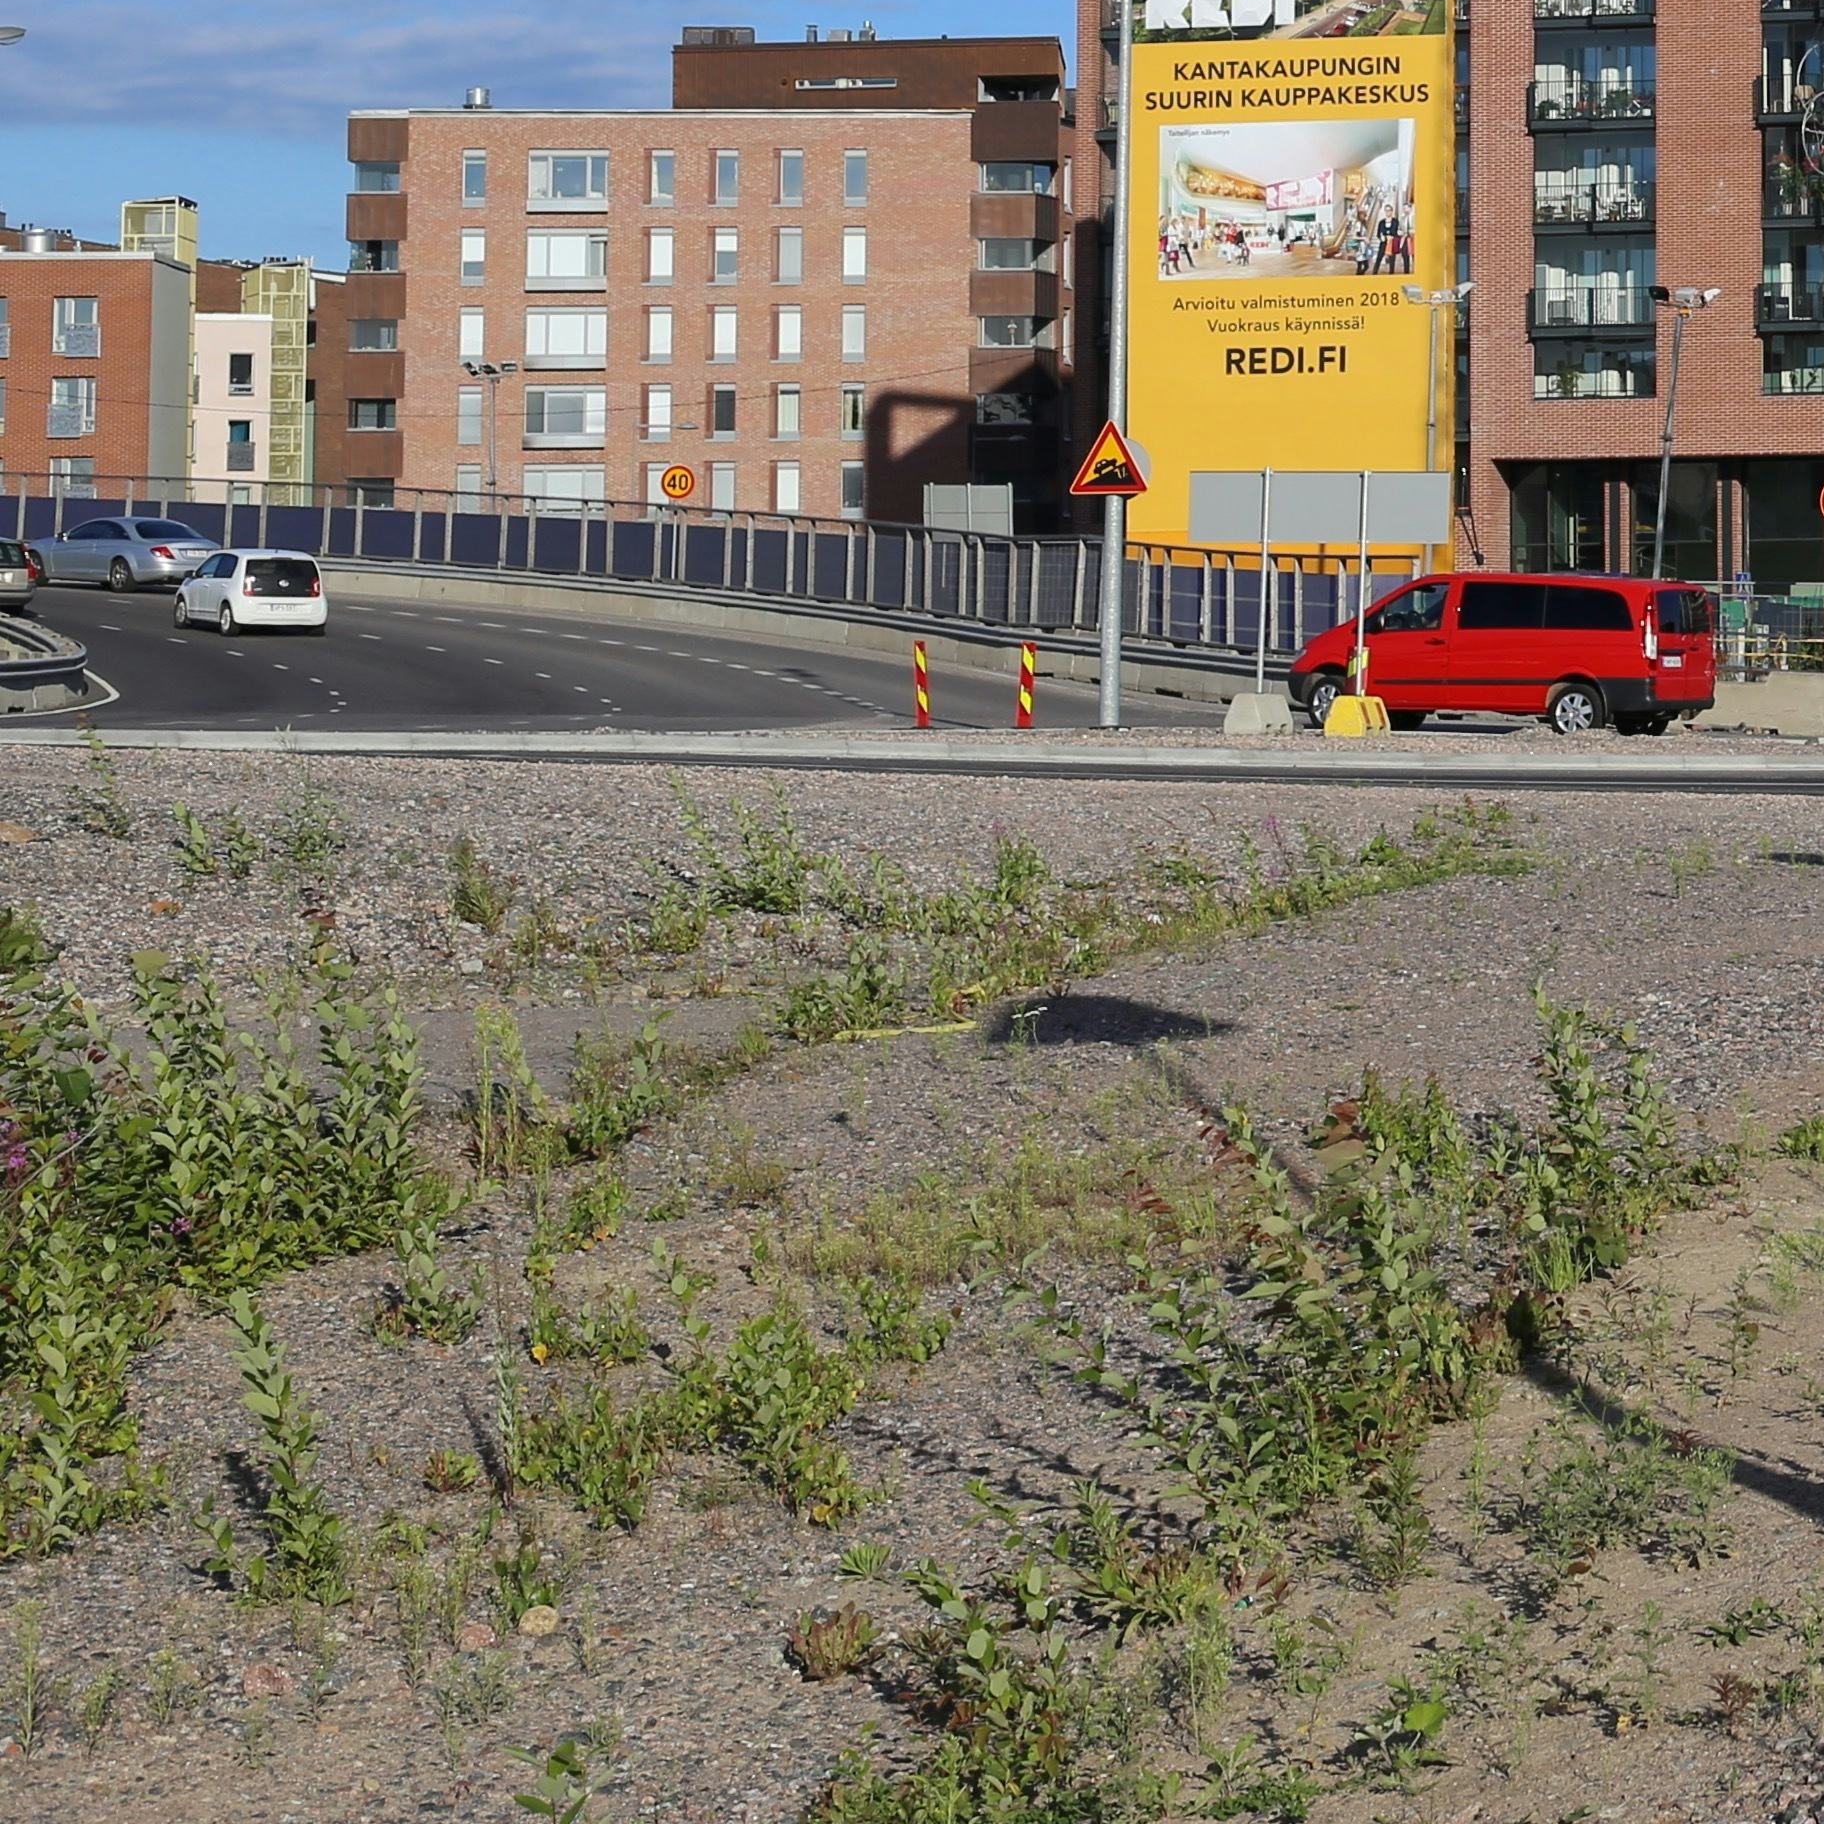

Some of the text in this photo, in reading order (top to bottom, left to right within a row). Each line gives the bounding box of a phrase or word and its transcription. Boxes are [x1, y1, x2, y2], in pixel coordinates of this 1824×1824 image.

[1174, 56, 1401, 80] KANTAKAUPUNGIN
[1145, 83, 1430, 111] SUURIN KAUPPAKESKUS
[1172, 292, 1400, 311] Arvioitu valmistuminen 2018
[1207, 315, 1365, 334] Vuokraus käynnissä!
[1225, 345, 1347, 375] REDI.FI
[667, 474, 689, 491] 40
